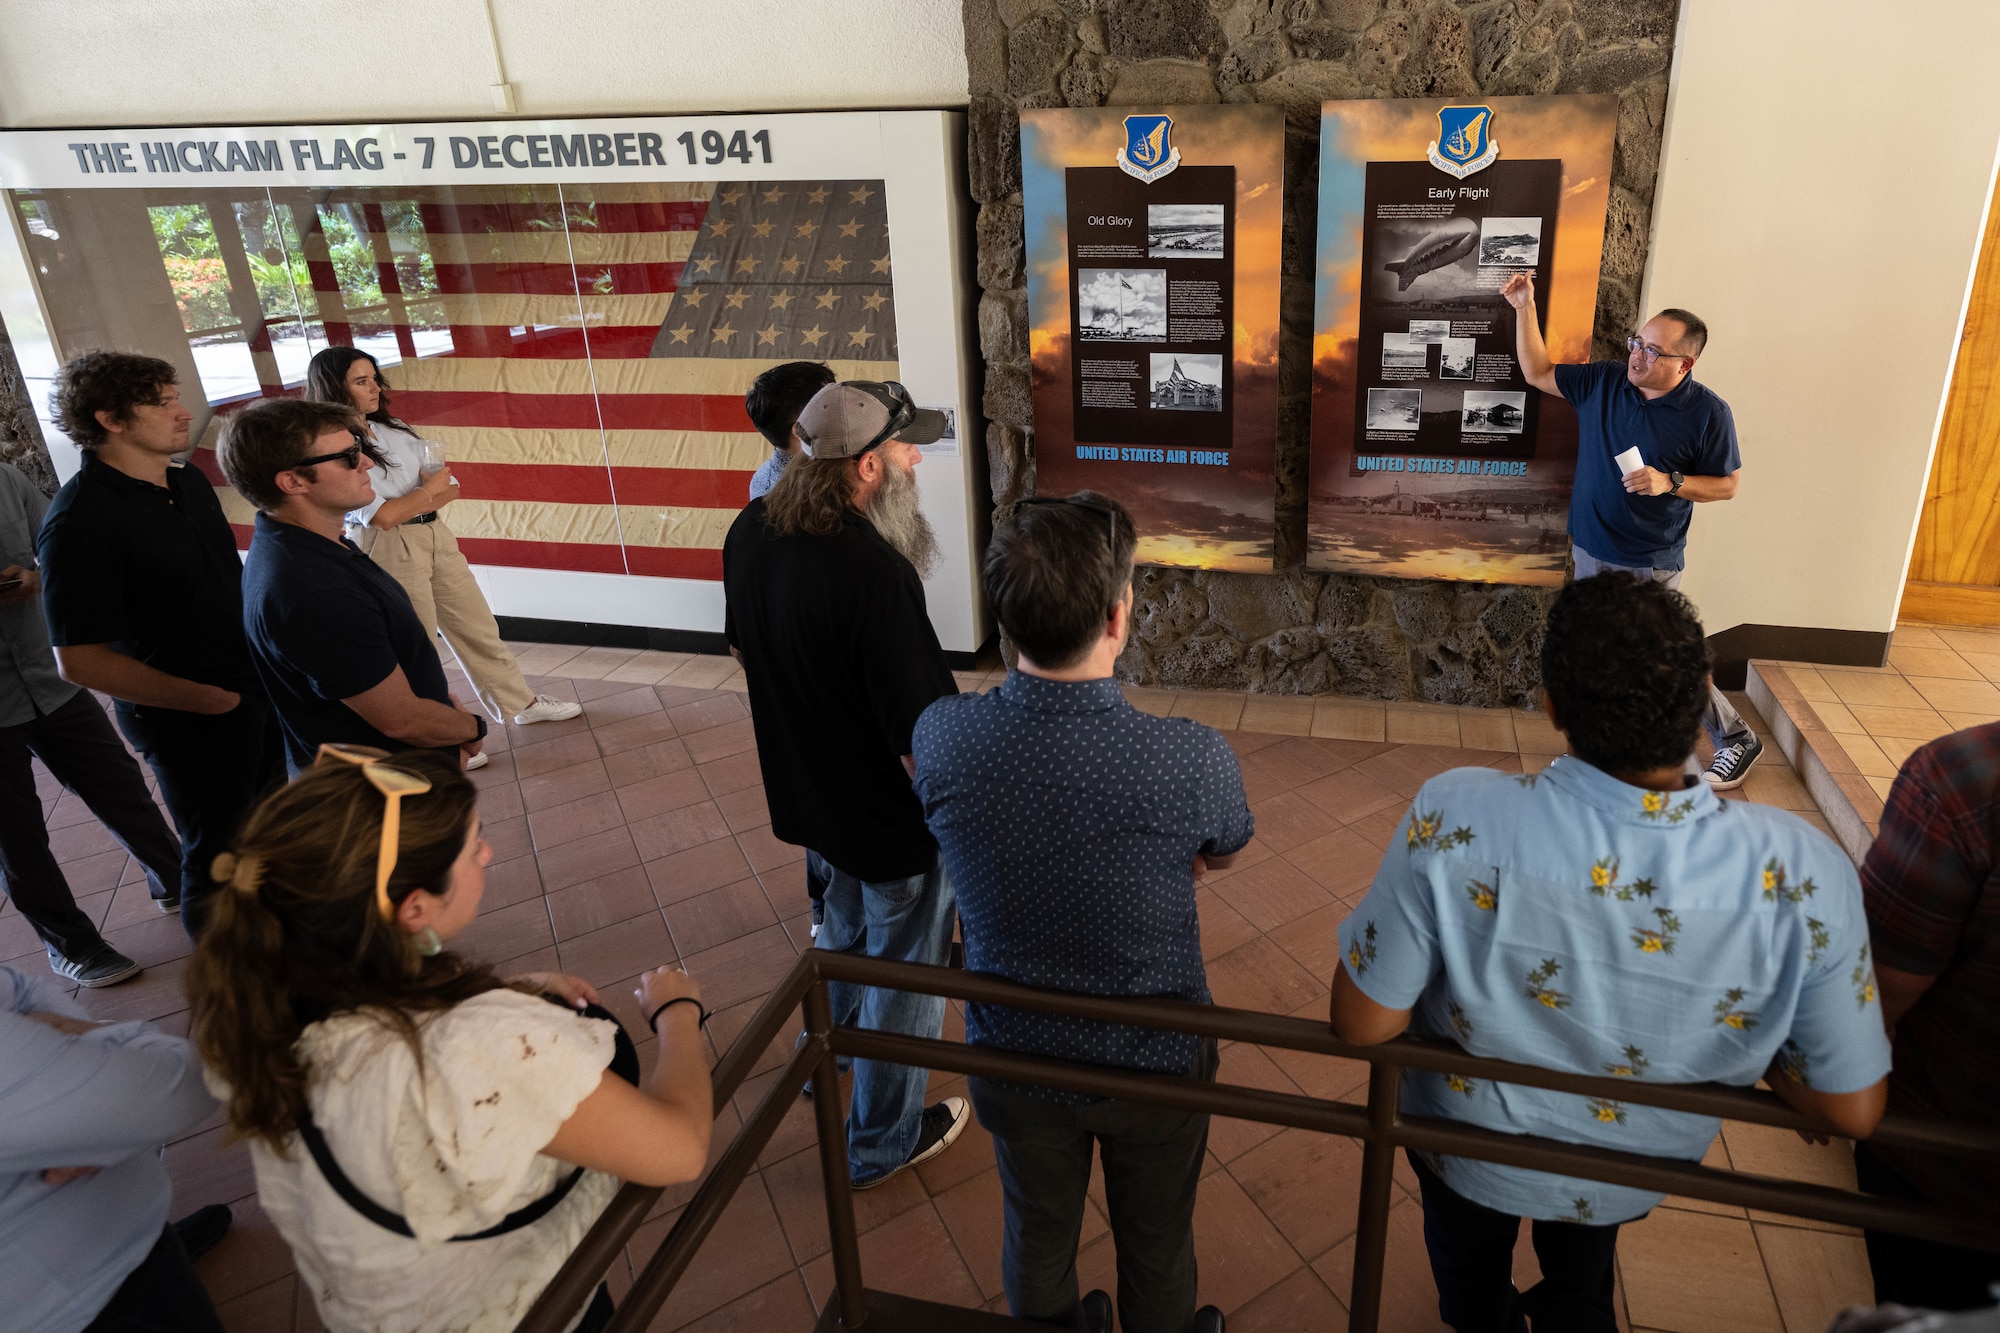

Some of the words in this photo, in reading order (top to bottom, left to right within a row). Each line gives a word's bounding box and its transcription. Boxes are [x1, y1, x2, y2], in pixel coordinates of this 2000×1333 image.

[68, 142, 137, 173] THE
[140, 140, 284, 173] HICKAM
[289, 138, 384, 171] FLAG
[414, 137, 435, 169] 7
[449, 132, 667, 169] DECEMBER
[677, 129, 773, 164] 1941
[1120, 160, 1143, 177] PACIFIC
[1142, 174, 1155, 182] AIR
[1154, 160, 1177, 177] FORCES
[1431, 155, 1454, 172] PACIFIC
[1453, 169, 1467, 177] AIR
[1467, 153, 1494, 172] FORCES
[1428, 187, 1456, 201] Early
[1459, 187, 1490, 201] Flight
[1087, 215, 1105, 226] Old
[1107, 215, 1133, 228] Glory
[1076, 445, 1119, 460] UNITED
[1121, 447, 1164, 463] STATES
[1166, 449, 1188, 464] AIR
[1190, 451, 1229, 466] FORCE
[1357, 456, 1404, 472] UNITED
[1407, 457, 1455, 474] STATES
[1457, 459, 1481, 475] AIR
[1483, 461, 1527, 477] FORCE
